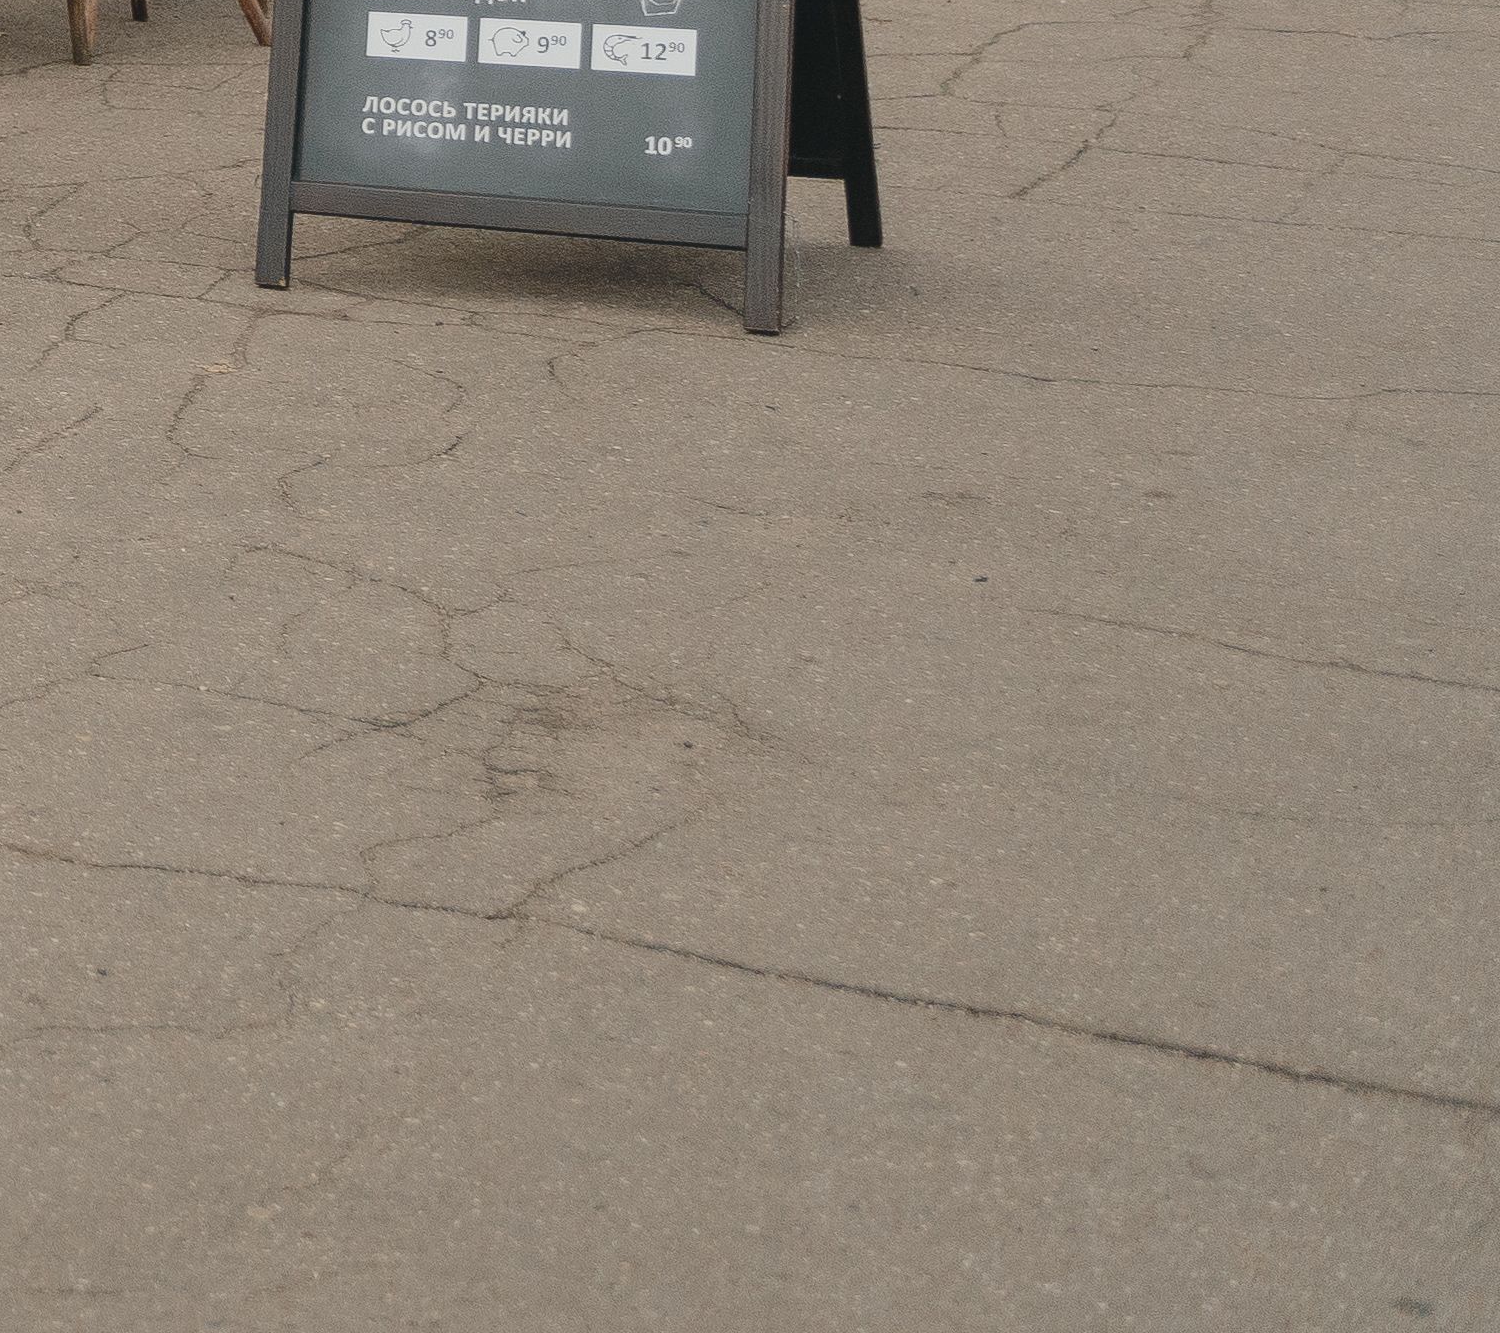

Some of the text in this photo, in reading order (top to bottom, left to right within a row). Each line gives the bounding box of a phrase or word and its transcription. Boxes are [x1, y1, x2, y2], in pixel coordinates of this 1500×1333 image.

[362, 96, 570, 126] ЛОСОСЬ ТЕРИЯКИ
[361, 117, 375, 135] С
[382, 118, 466, 141] РИСОМ
[474, 126, 490, 143] И
[497, 126, 572, 149] ЧЕРРИ
